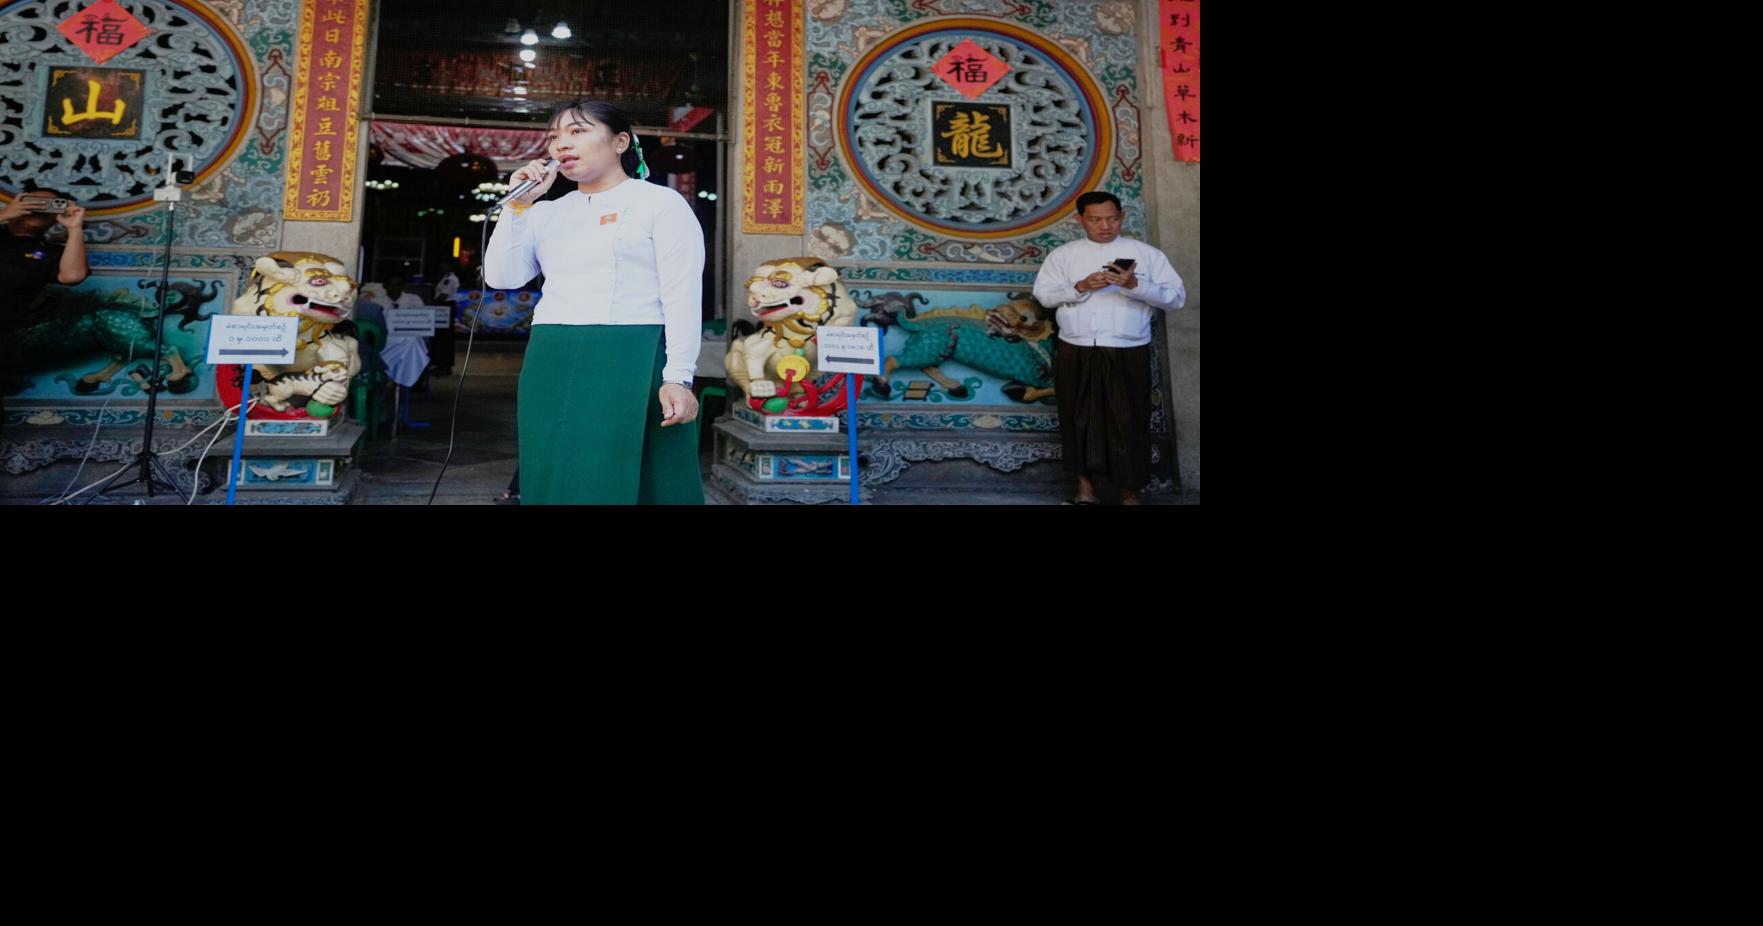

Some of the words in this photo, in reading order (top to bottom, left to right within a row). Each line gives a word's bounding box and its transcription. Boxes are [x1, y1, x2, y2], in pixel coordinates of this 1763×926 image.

[75, 13, 128, 45] 福
[947, 54, 989, 83] 福
[1167, 0, 1199, 148] 到青山草木新
[61, 80, 126, 125] 山
[306, 0, 347, 207] 此日南宗俎豆舊雲礽
[941, 111, 1004, 159] 龍
